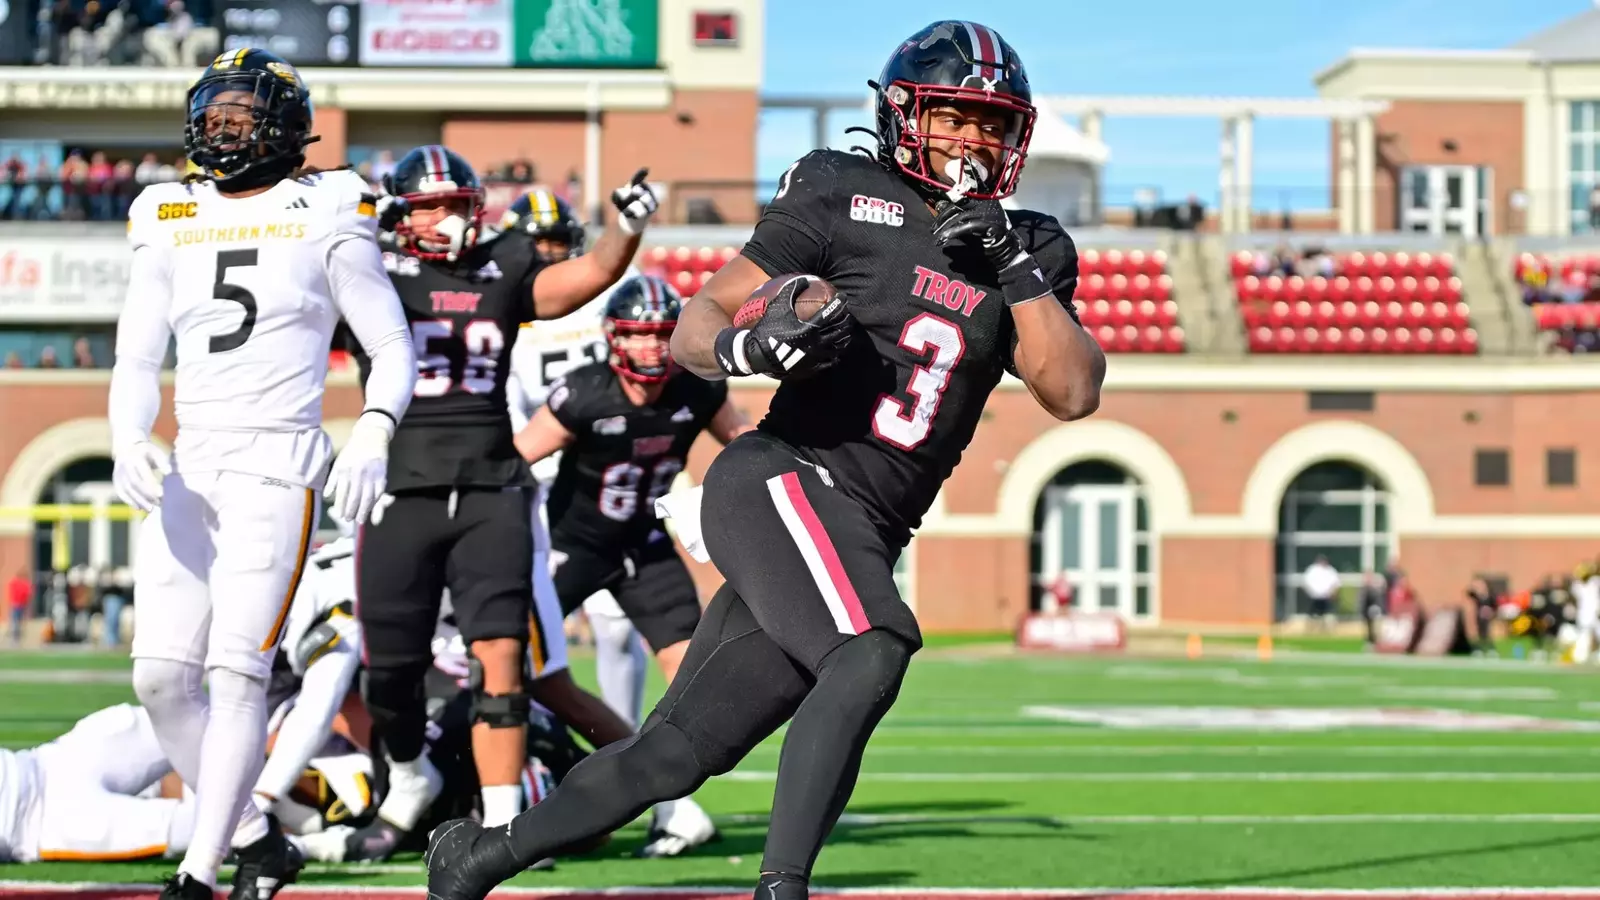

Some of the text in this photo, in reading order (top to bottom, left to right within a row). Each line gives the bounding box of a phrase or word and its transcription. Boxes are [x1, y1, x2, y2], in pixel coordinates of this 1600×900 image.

[158, 202, 198, 220] SBC
[850, 195, 904, 226] SBC
[173, 223, 308, 247] SOUTHERN MISS
[209, 249, 258, 353] 5
[429, 290, 483, 313] TROY
[912, 265, 987, 317] TROY
[412, 318, 504, 398] 58
[872, 312, 966, 452] 3
